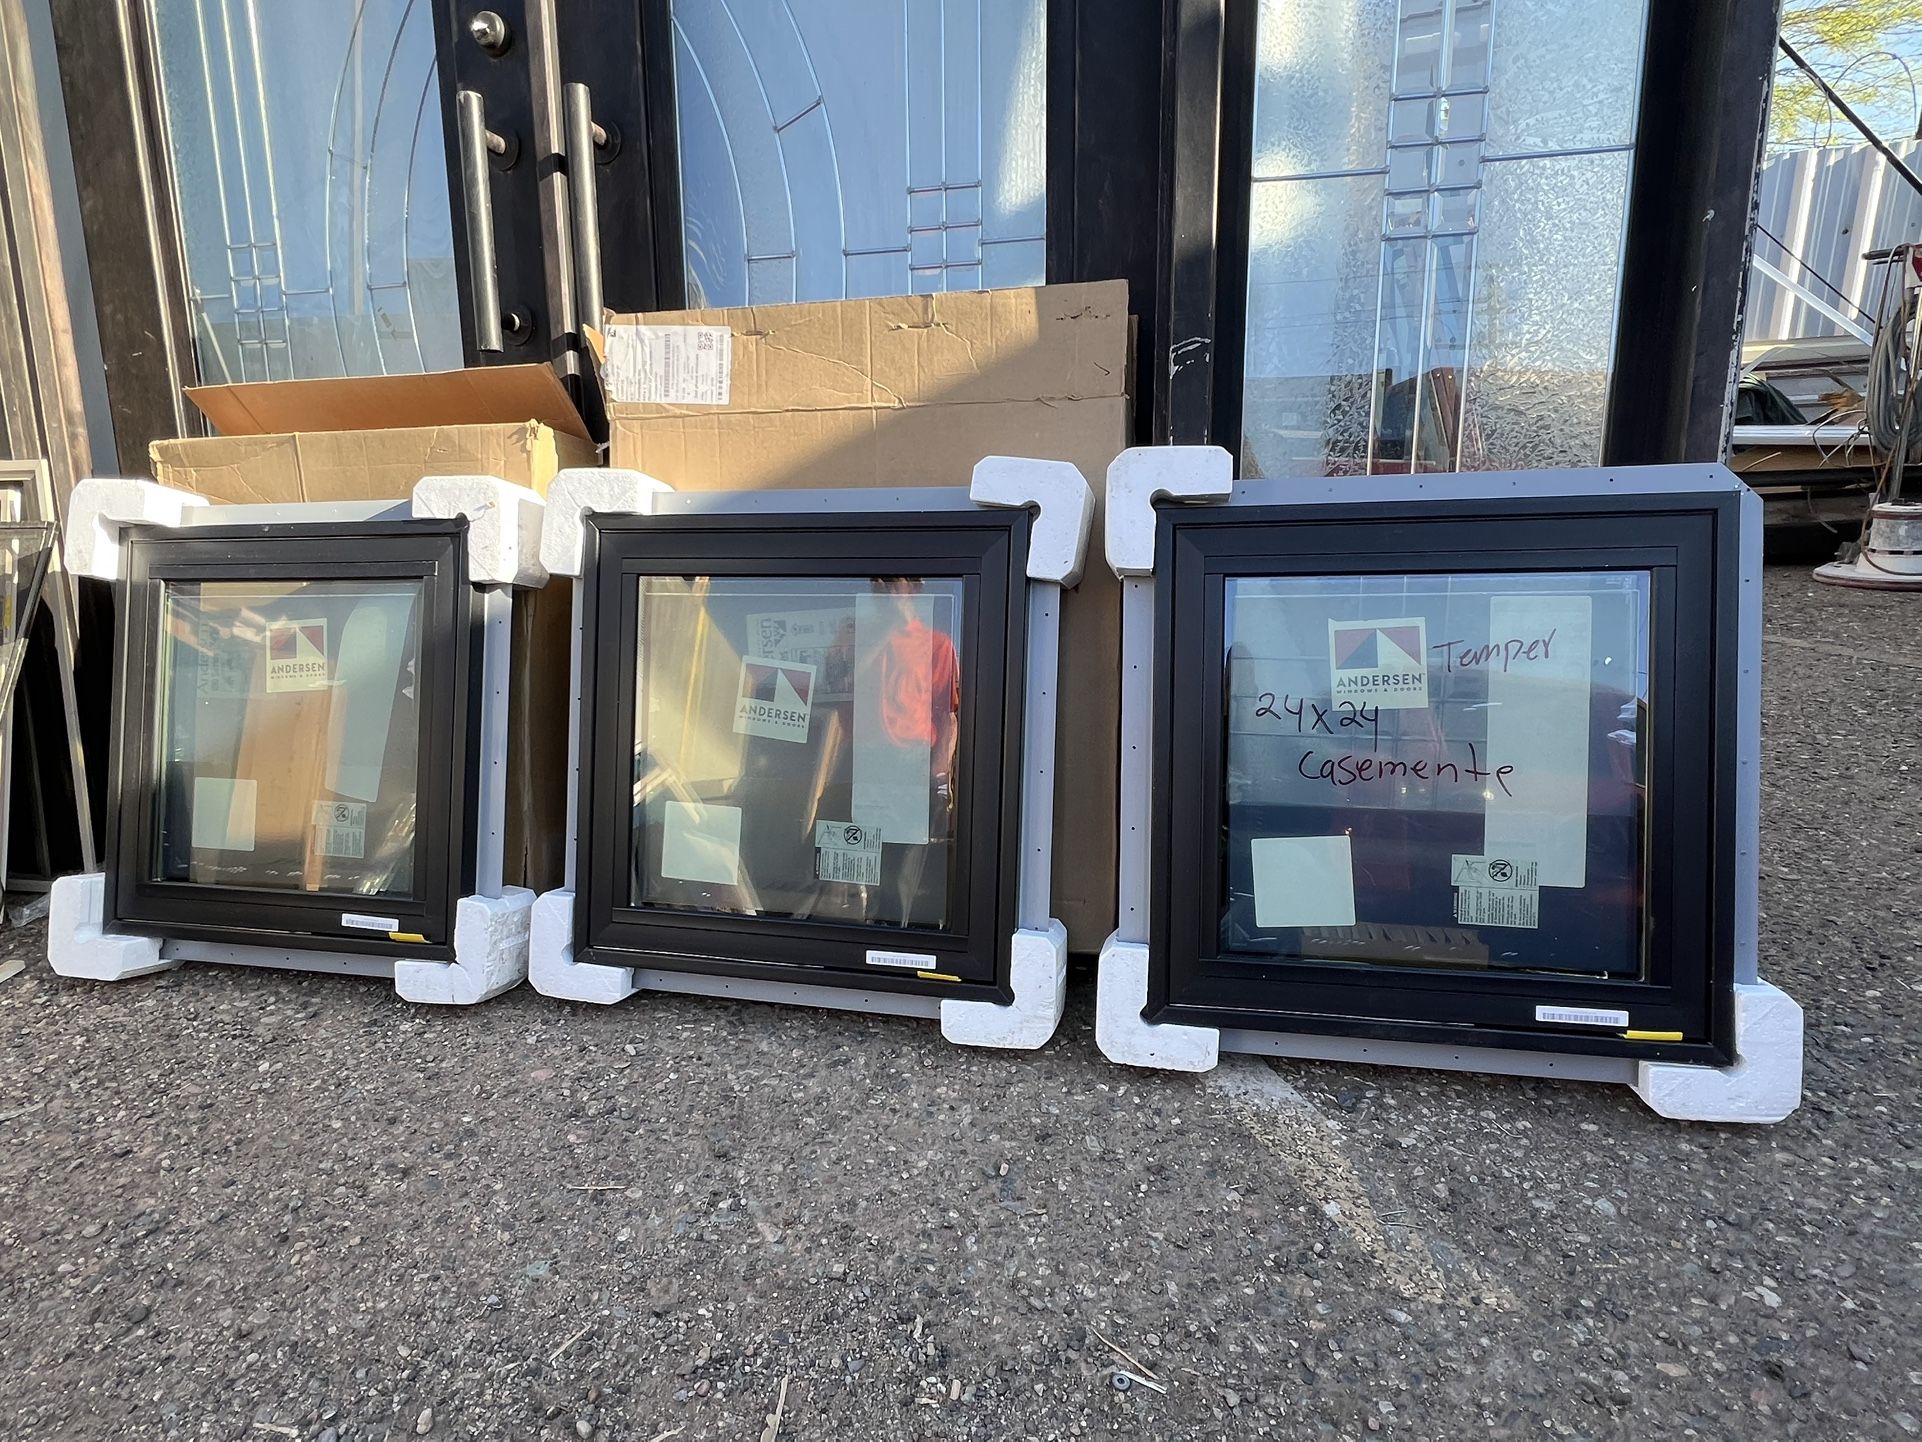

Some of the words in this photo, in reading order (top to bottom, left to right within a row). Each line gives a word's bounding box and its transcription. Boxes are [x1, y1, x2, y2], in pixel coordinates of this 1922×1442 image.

[1432, 628, 1556, 672] Temper
[271, 662, 325, 675] ANDERSEN
[1336, 673, 1423, 688] ANDERSEN
[740, 705, 807, 723] ANDERSEN
